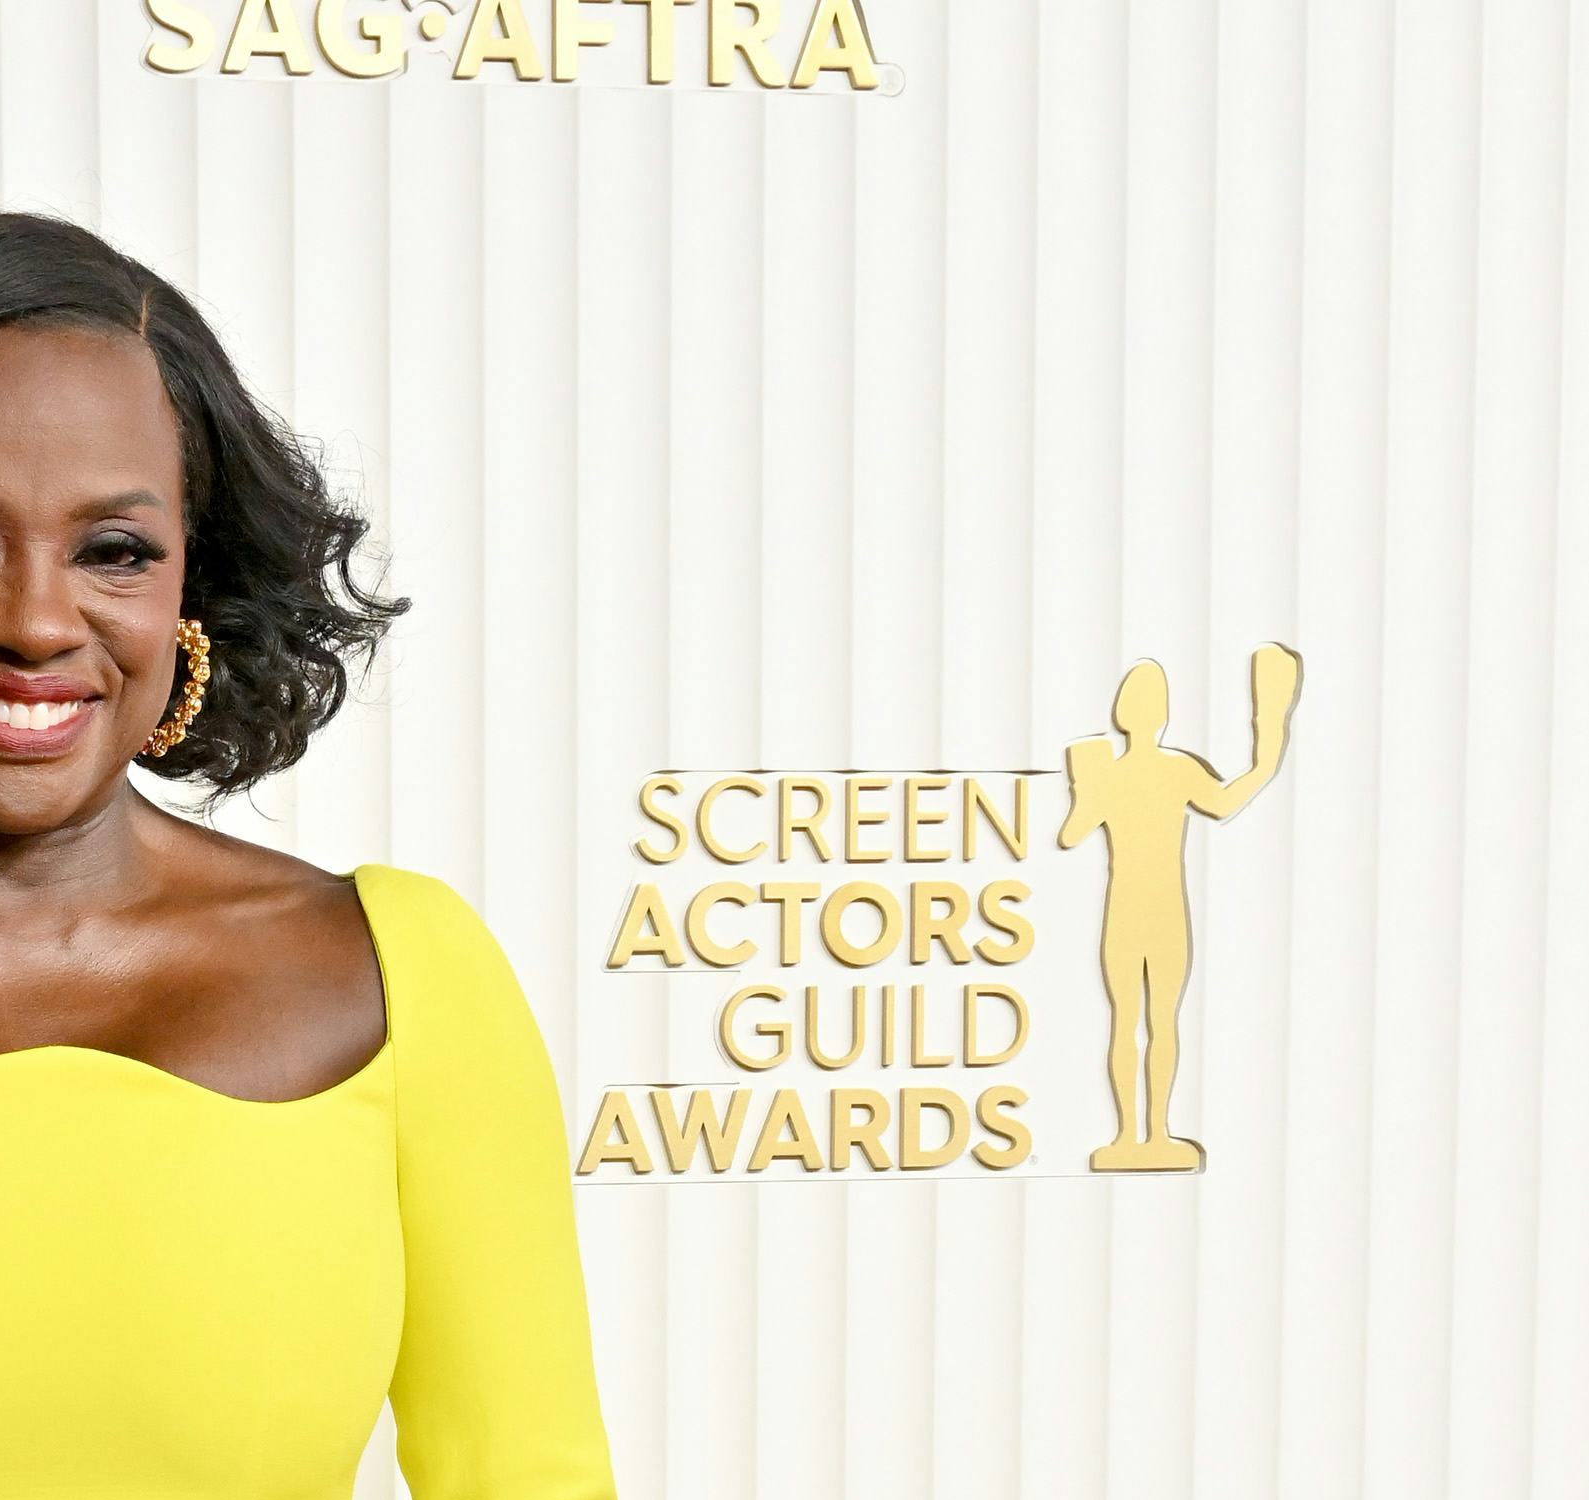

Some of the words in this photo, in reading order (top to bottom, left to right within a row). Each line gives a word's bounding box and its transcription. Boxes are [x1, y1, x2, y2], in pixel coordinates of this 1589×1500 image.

[633, 776, 1029, 865] SCREEN
[606, 880, 1035, 969] ACTORS
[718, 984, 1030, 1070] GUILD
[576, 1085, 1032, 1175] AWARDS
